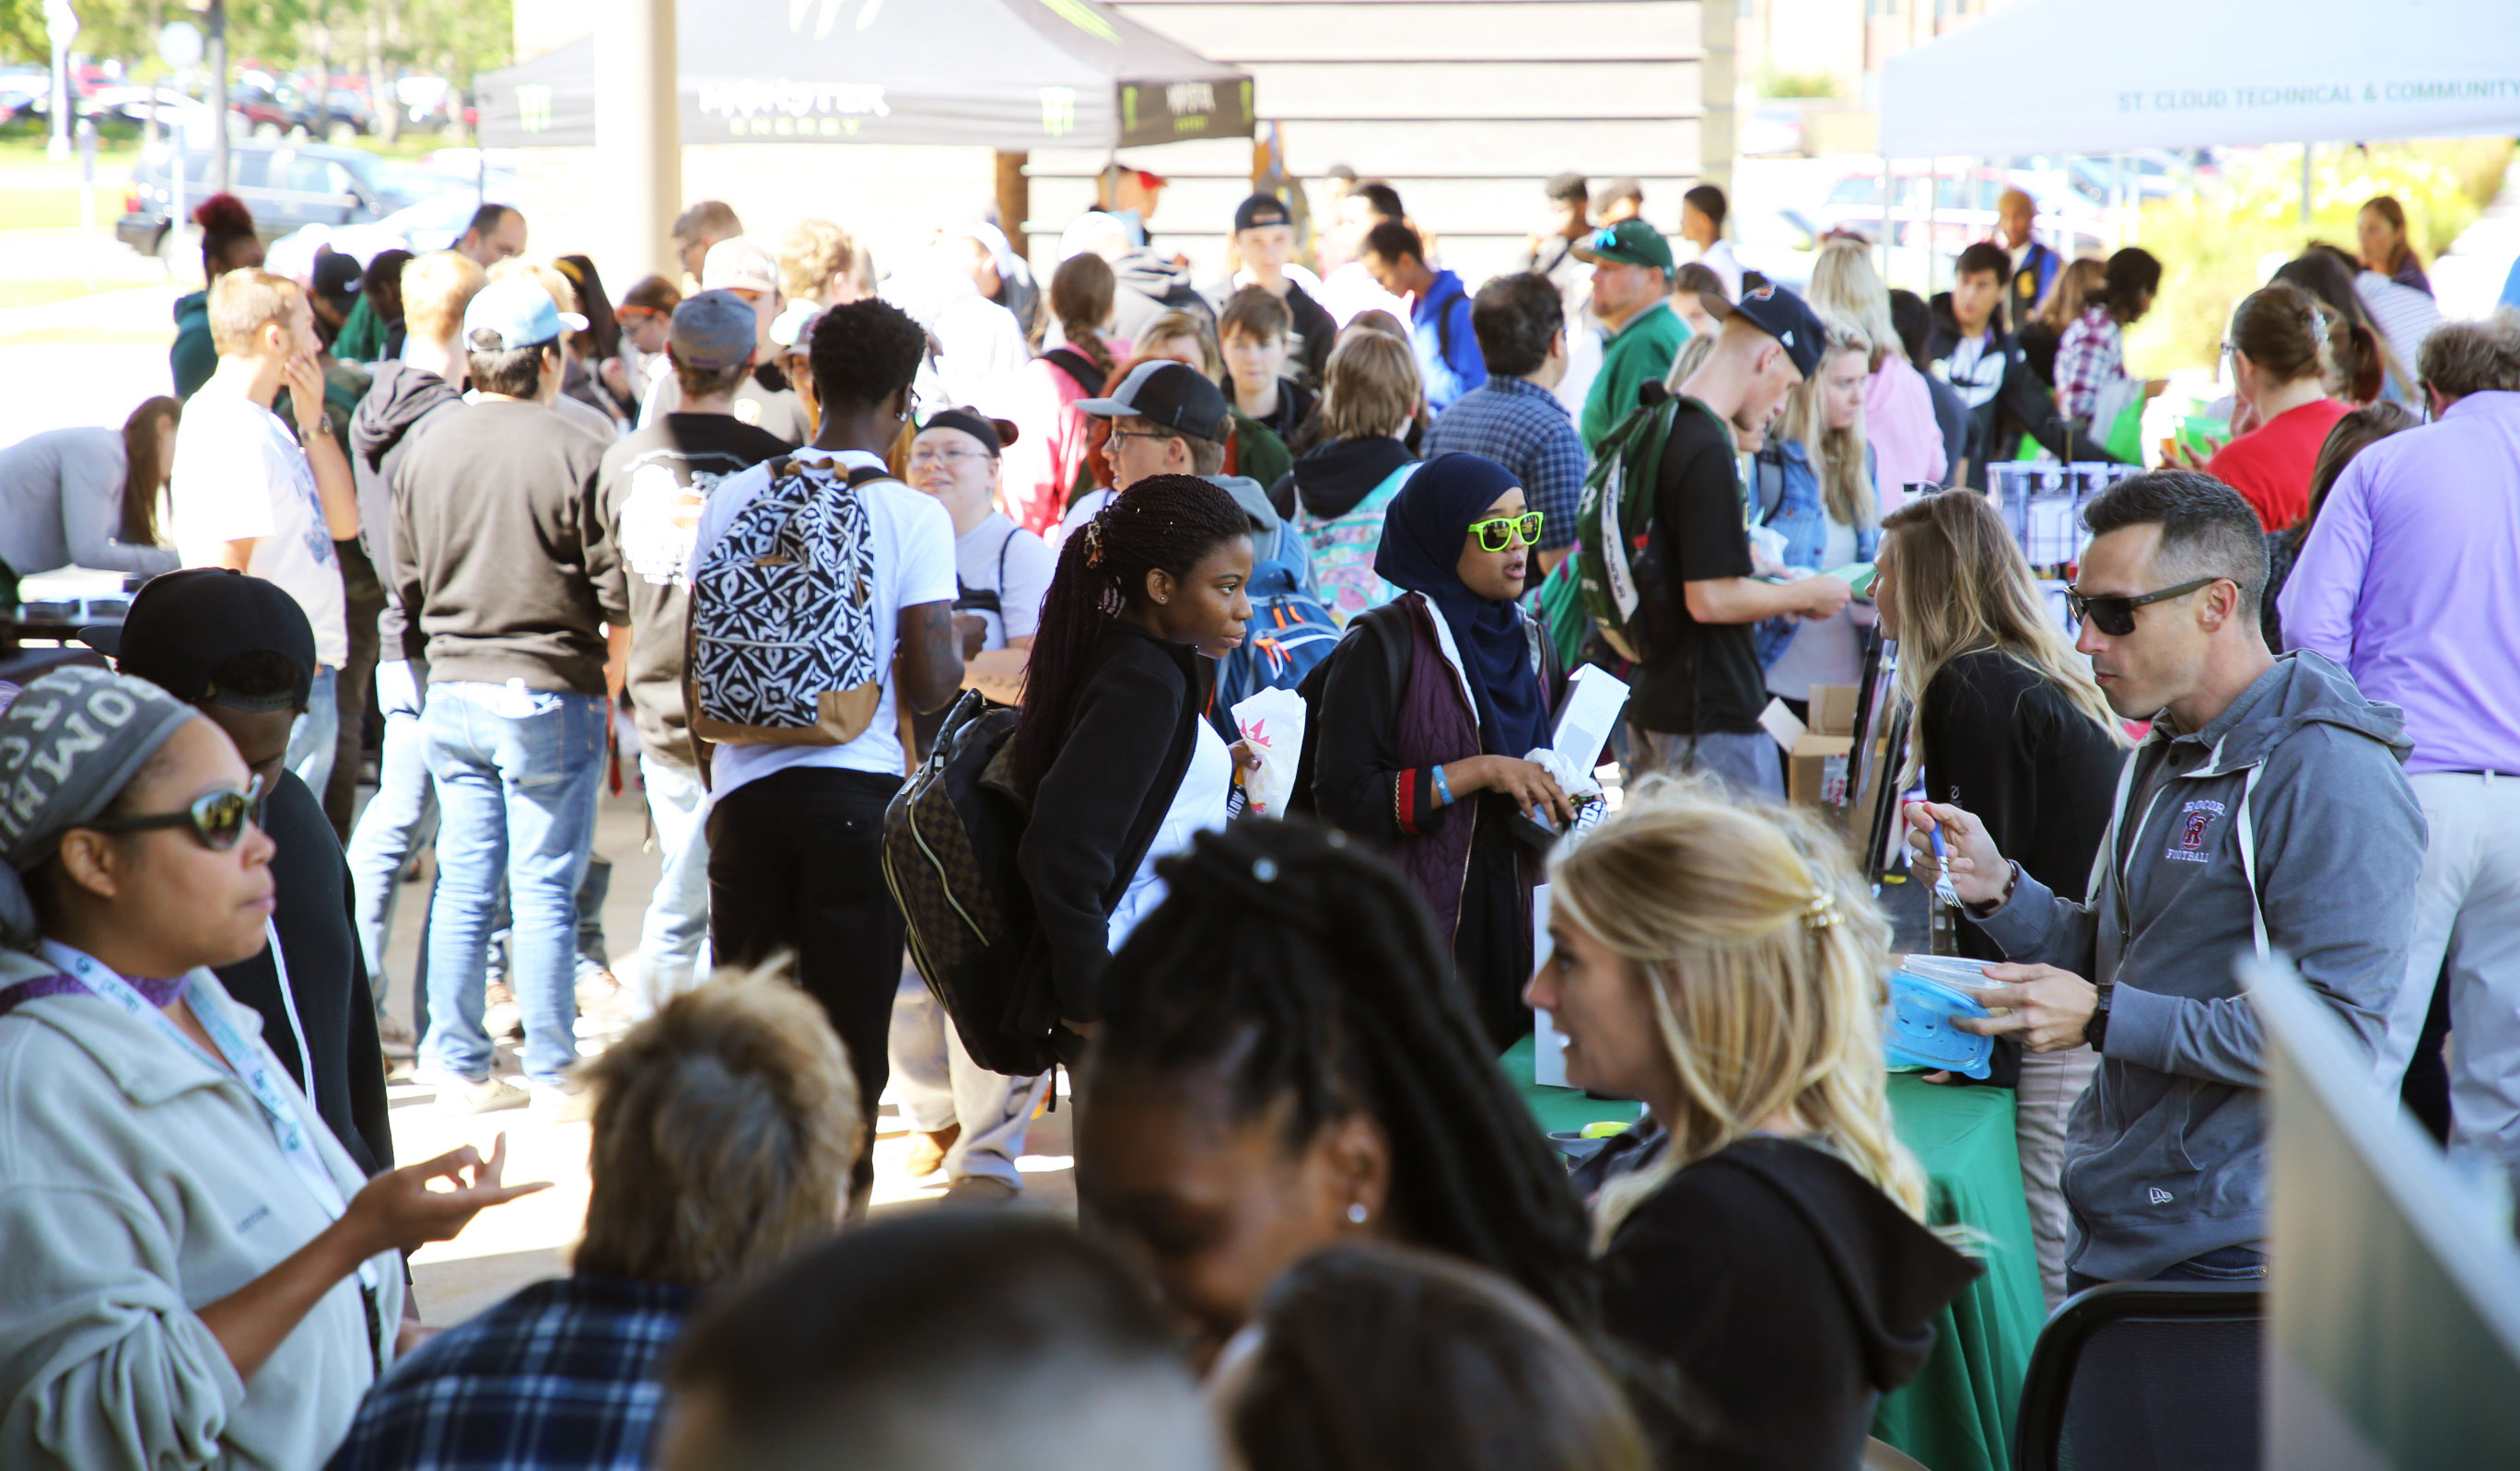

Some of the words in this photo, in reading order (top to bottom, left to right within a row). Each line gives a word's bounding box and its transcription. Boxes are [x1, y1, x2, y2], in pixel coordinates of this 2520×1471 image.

[2118, 91, 2146, 113] ST.
[2154, 89, 2227, 111] CLOUD
[2236, 84, 2354, 109] TECHNICAL
[2362, 84, 2378, 102] &
[2386, 79, 2520, 102] COMMUNITY
[729, 117, 860, 135] ENERGY
[2165, 848, 2210, 863] FOOTBALL
